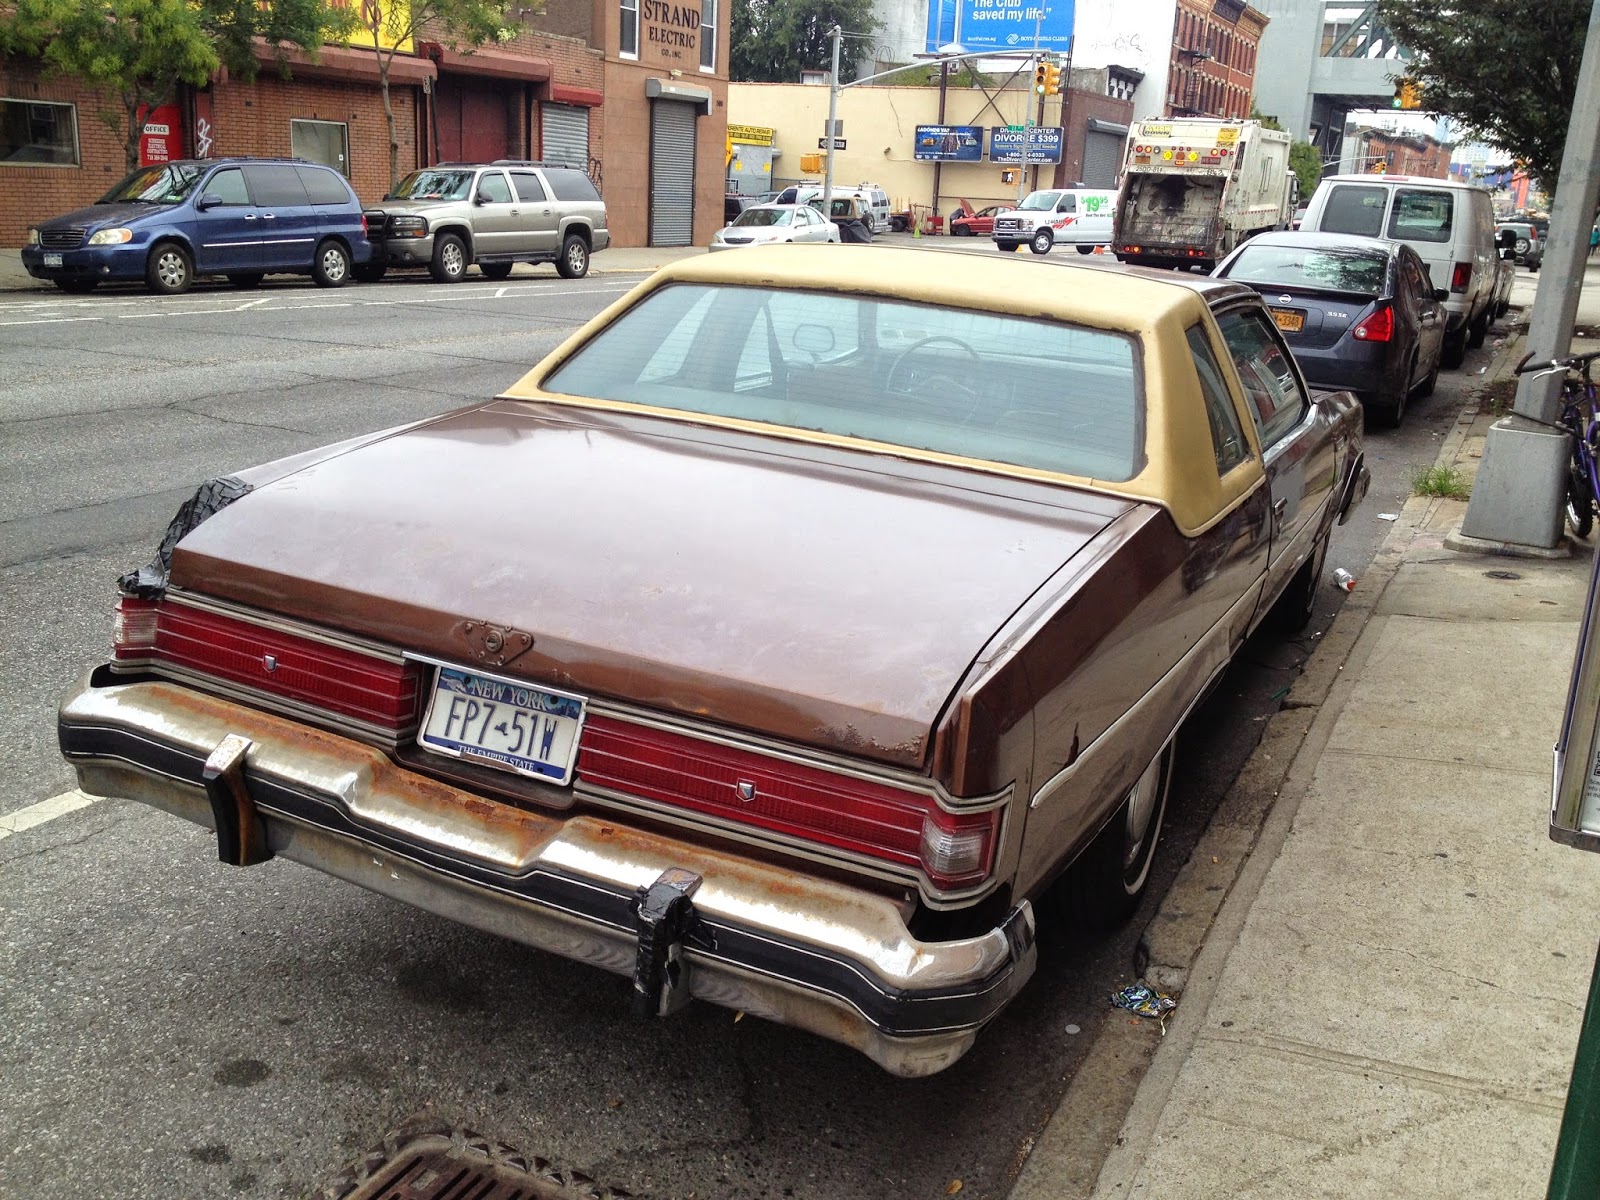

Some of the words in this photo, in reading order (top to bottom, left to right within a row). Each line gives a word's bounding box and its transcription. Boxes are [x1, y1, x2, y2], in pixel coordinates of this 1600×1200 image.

[644, 0, 700, 30] STRAND
[973, 8, 1005, 20] saved
[1007, 10, 1024, 22] my
[649, 26, 696, 49] ELECTRIC
[1037, 135, 1059, 143] $399
[471, 678, 506, 701] NEW
[509, 684, 548, 711] YORK
[458, 744, 476, 754] THE
[509, 757, 535, 771] STATE
